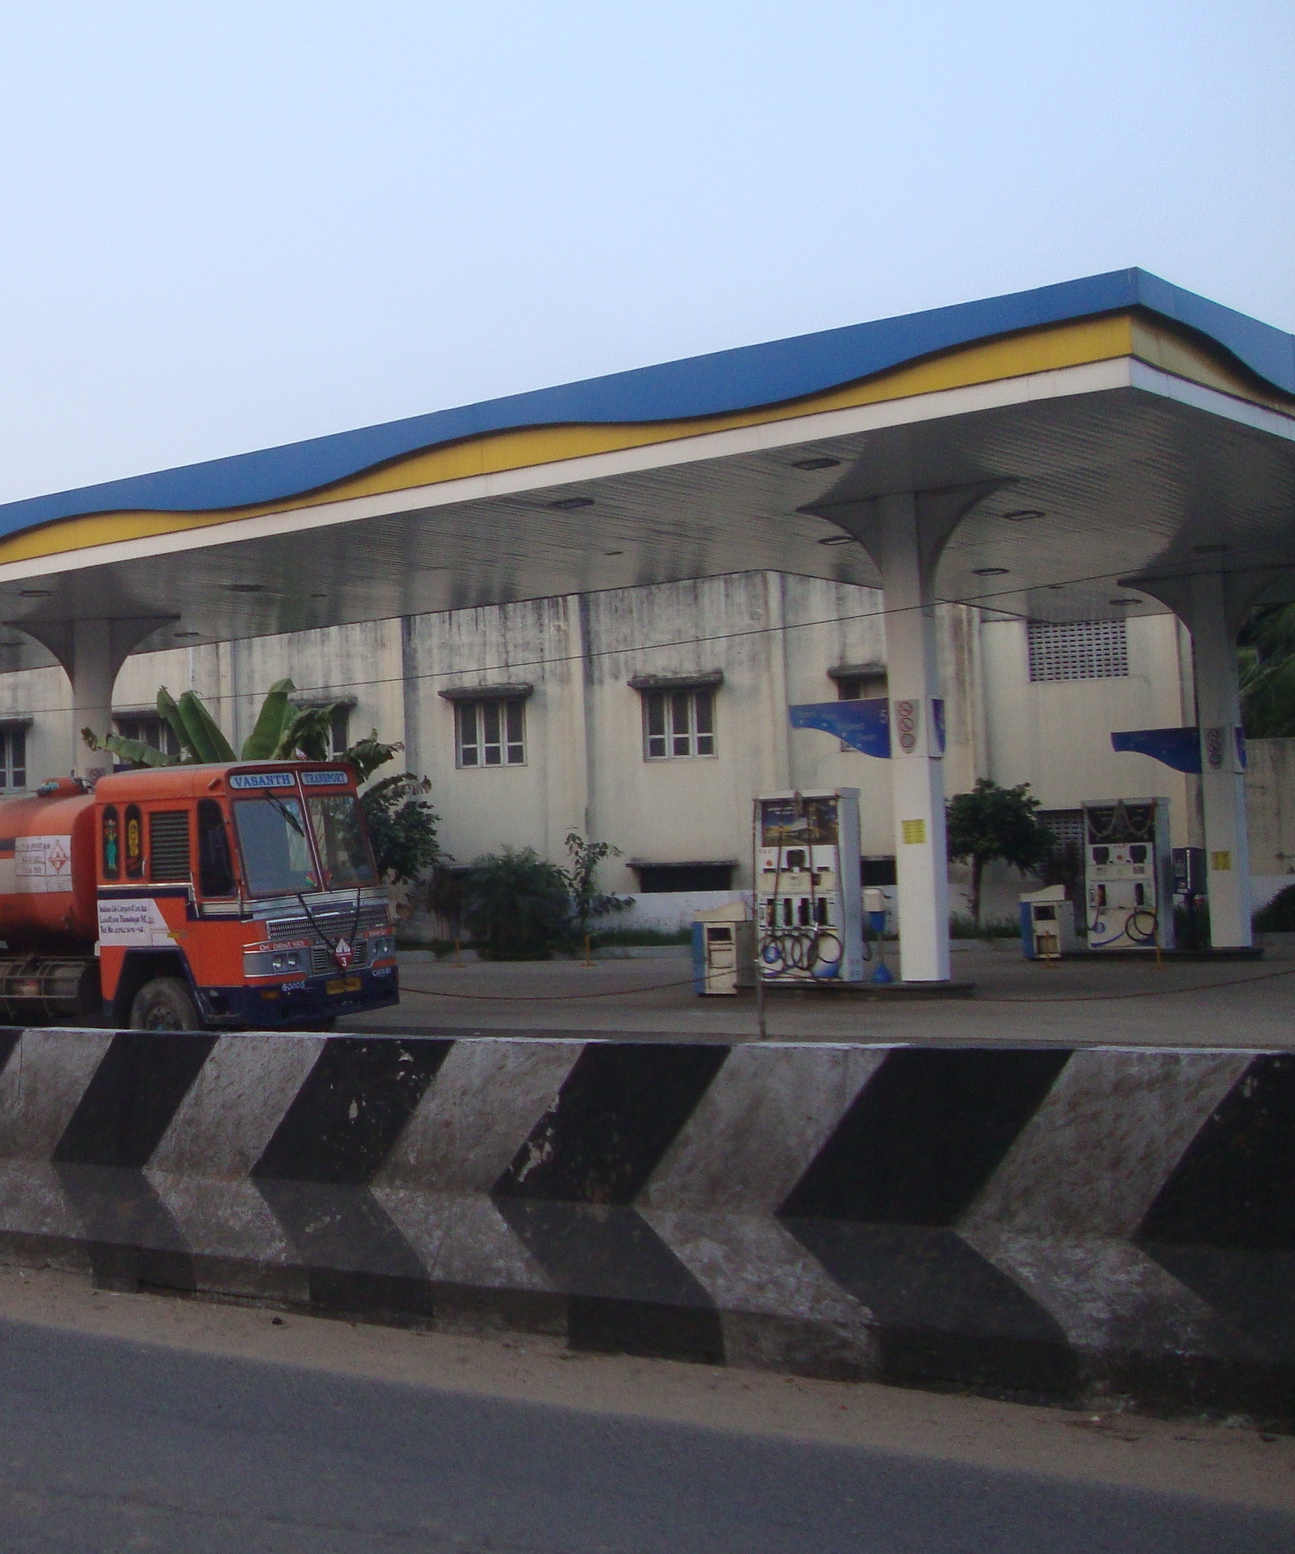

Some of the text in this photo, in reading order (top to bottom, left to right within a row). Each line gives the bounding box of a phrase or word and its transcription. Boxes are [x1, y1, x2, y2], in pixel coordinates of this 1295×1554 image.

[234, 772, 346, 788] VASANTH TRANSPORT
[341, 957, 347, 967] 3
